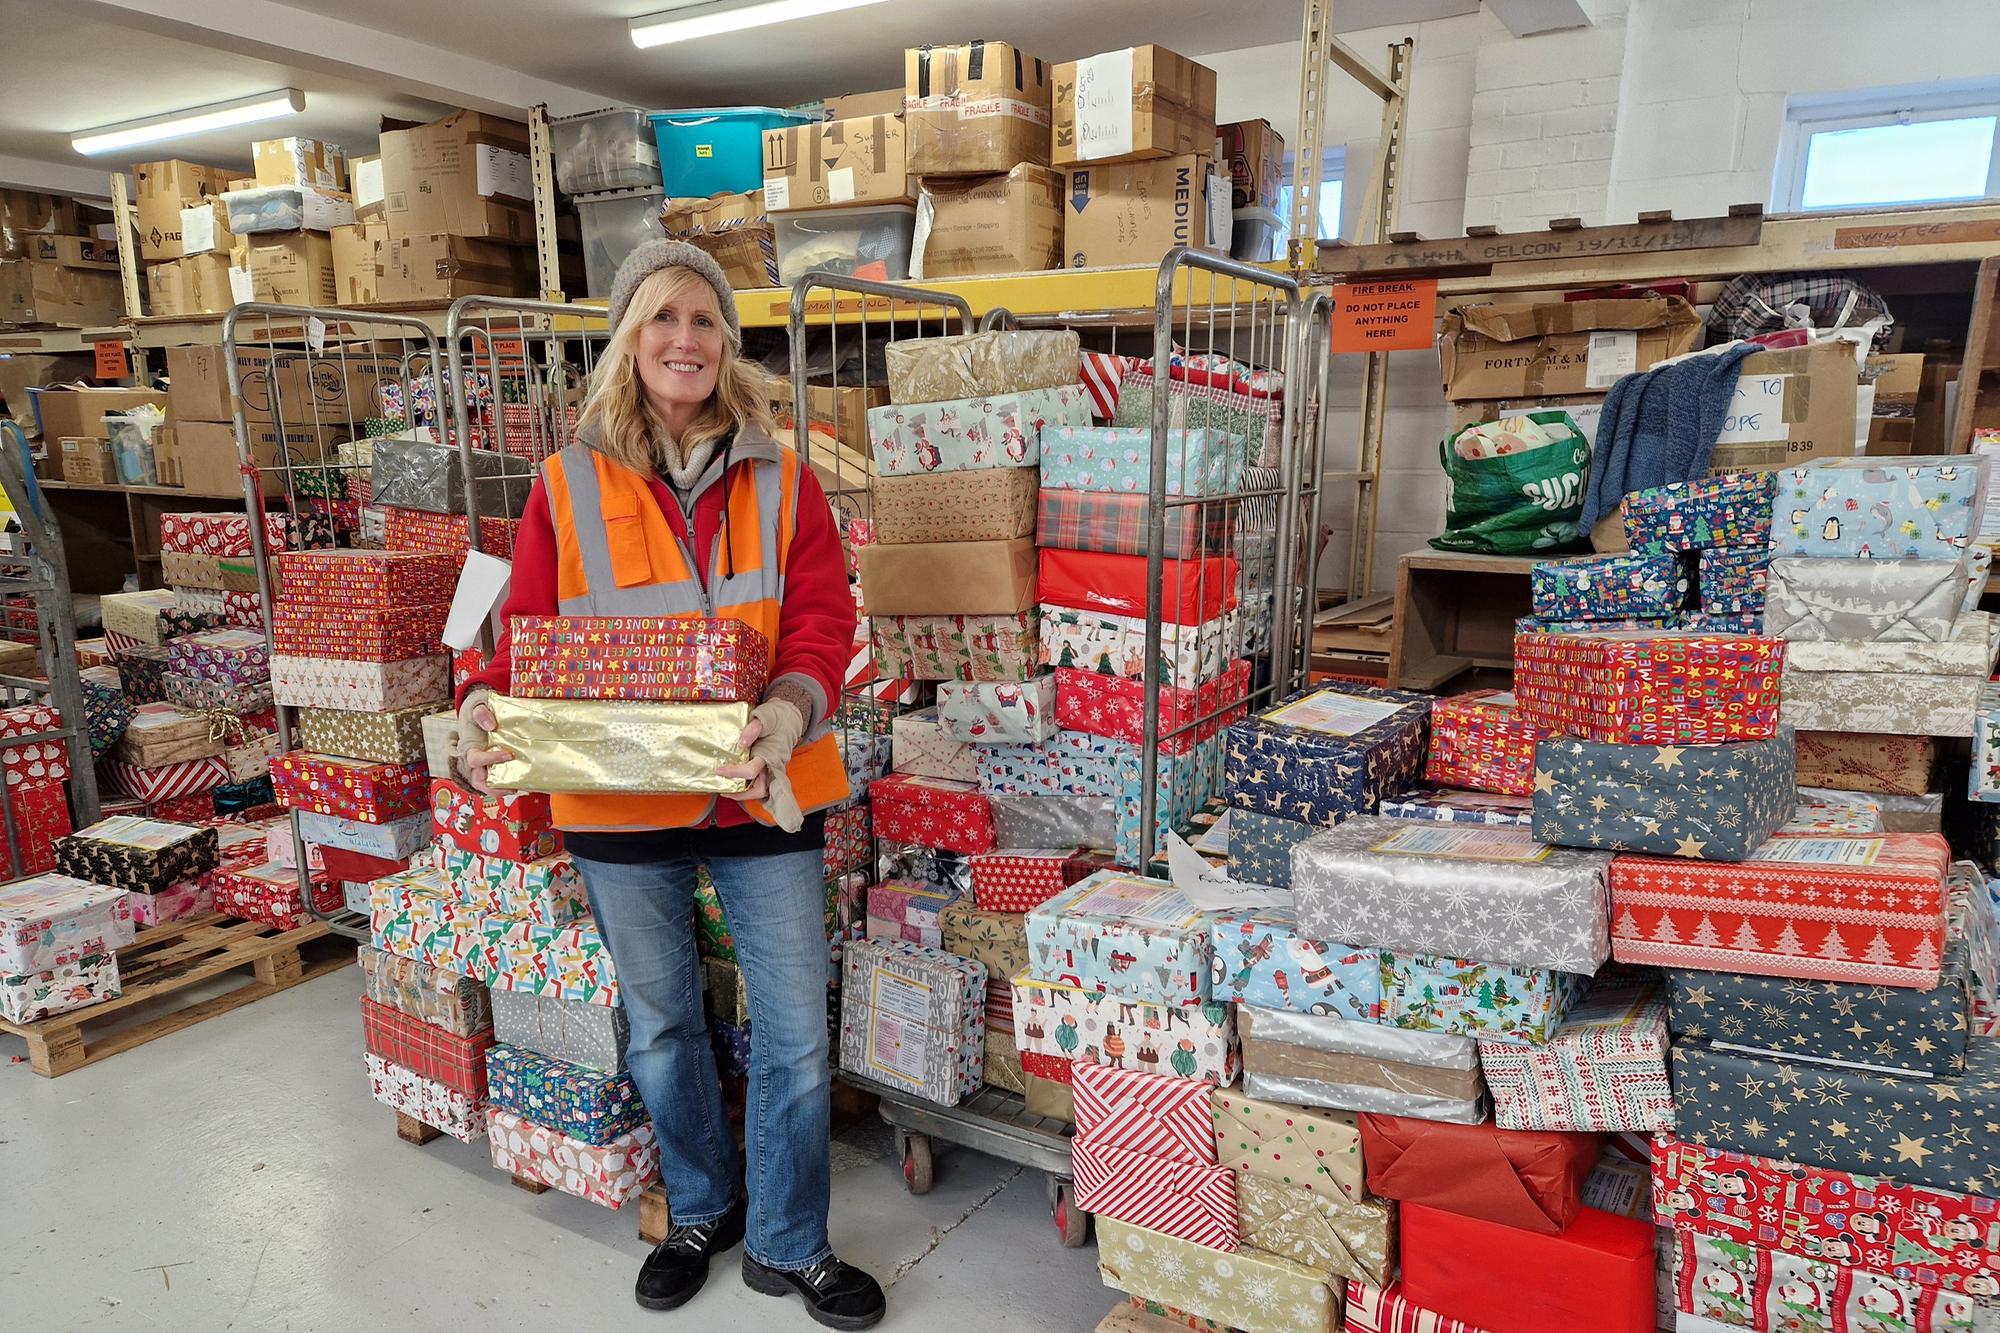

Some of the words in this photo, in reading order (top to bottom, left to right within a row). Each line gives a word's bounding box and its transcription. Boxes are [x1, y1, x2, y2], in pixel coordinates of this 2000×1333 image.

[906, 99, 928, 109] AGILE
[964, 102, 1001, 116] FRAGILE
[1011, 103, 1030, 117] FRAGILE
[854, 129, 900, 144] SUER
[1074, 176, 1087, 184] UP
[1136, 180, 1153, 221] LADIES
[1174, 168, 1190, 247] MEDIU
[1483, 241, 1562, 259] CELCON
[1352, 285, 1376, 295] FIRE
[1378, 283, 1416, 294] BREAK.
[1346, 303, 1361, 313] DO
[1363, 302, 1385, 312] NOT
[1387, 300, 1420, 311] PLACE
[1355, 315, 1408, 325] ANYTHING
[1365, 329, 1396, 338] HERE!
[253, 358, 291, 369] SHOOXES
[1484, 355, 1557, 369] FORTNM
[1560, 354, 1571, 363] &
[312, 372, 333, 380] Lnk
[1760, 378, 1782, 395] TO
[1724, 412, 1762, 431] OPE
[1787, 441, 1813, 452] 1839
[1707, 503, 1718, 511] Ho
[555, 619, 623, 630] GREETIGS
[626, 619, 677, 630] SASONS
[540, 633, 585, 644] MERY
[604, 633, 674, 645] CHRISTMS
[676, 633, 721, 645] MERY
[573, 645, 641, 657] GREETIGS
[645, 646, 696, 657] SASONS
[511, 660, 556, 672] CHRIST
[559, 660, 603, 672] MERY
[622, 660, 692, 672] CHRISTMS
[569, 673, 638, 684] GREETIGS
[641, 673, 692, 684] SASONS
[555, 686, 599, 698] MERY
[619, 686, 689, 698] CHRISTMS
[692, 686, 736, 698] MERY
[1505, 714, 1522, 770] GREETING
